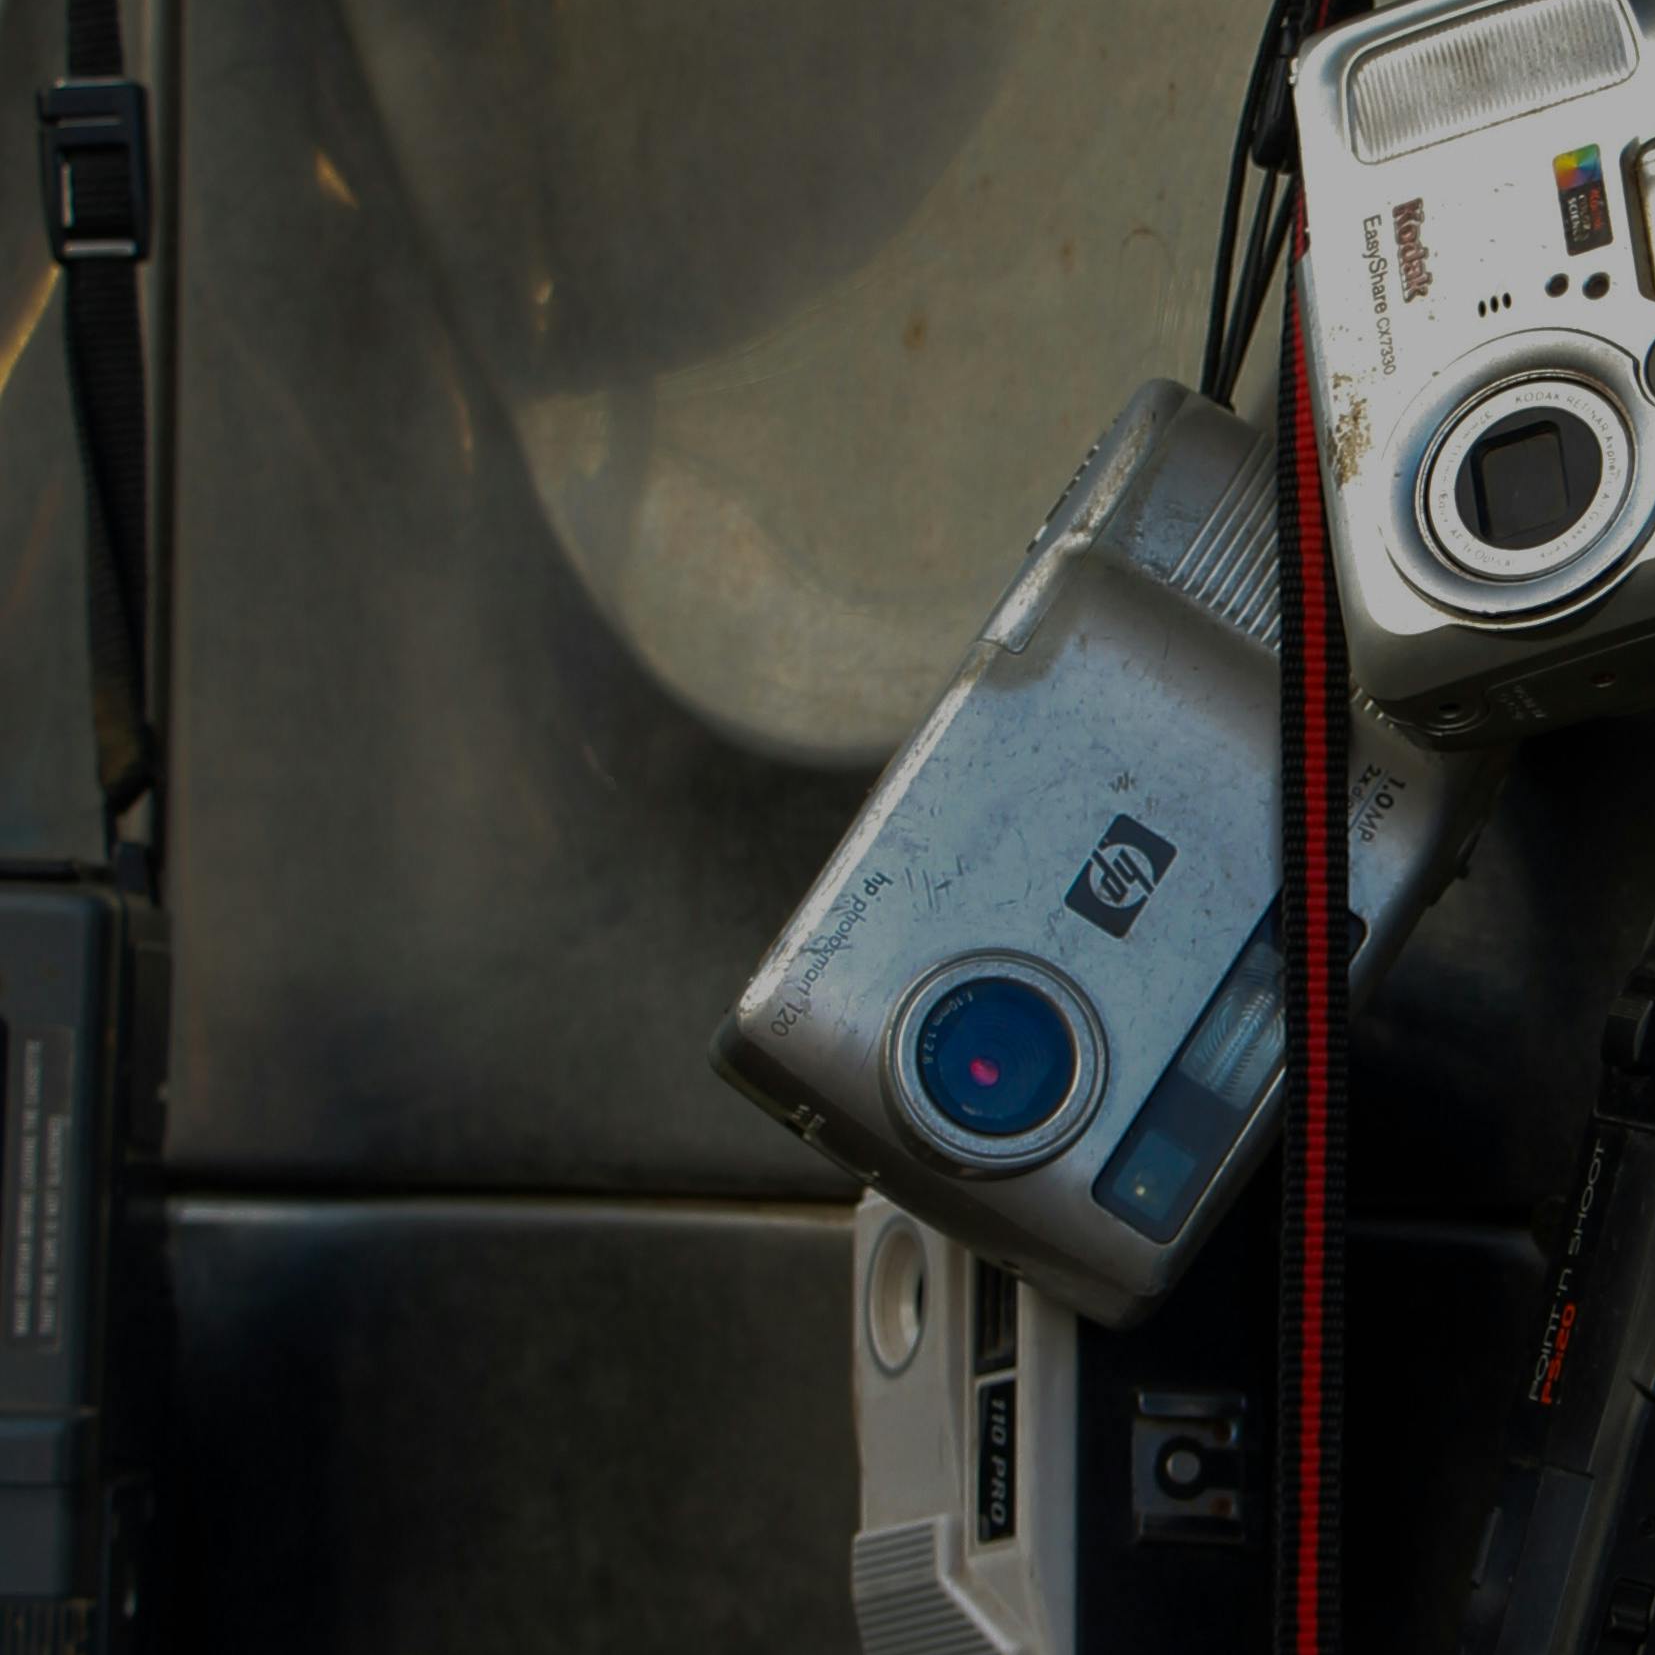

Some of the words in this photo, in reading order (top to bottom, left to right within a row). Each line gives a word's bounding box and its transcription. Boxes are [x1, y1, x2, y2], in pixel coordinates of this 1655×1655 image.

[1392, 197, 1434, 304] Kodak
[1362, 214, 1389, 314] EasyShare
[1376, 316, 1397, 376] CX7330
[863, 872, 893, 896] hp
[797, 896, 866, 996] photosmart
[770, 1002, 803, 1037] 120
[1528, 1303, 1562, 1401] POINT
[1567, 1136, 1605, 1256] SHOOT
[990, 1397, 1008, 1446] 110
[990, 1454, 1008, 1526] PRO
